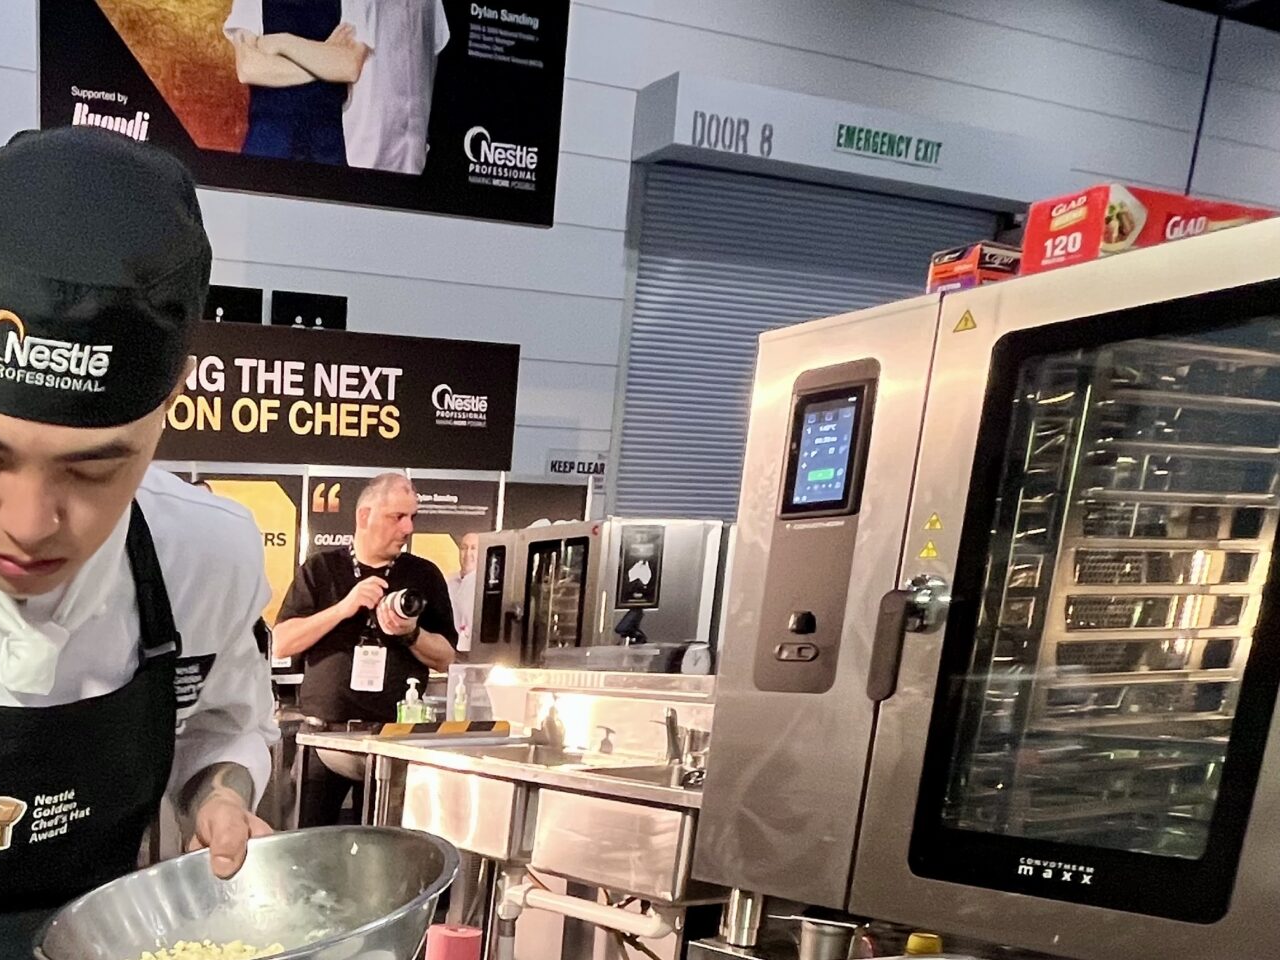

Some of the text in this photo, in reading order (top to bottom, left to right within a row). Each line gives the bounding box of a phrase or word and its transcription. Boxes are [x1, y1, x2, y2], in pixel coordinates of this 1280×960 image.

[470, 2, 540, 30] Dylan Sanding
[71, 85, 129, 105] Supported by
[692, 110, 774, 157] DOOR 8
[836, 124, 942, 164] EMERGENCY EXIT
[468, 162, 537, 181] PROFESSIONAL
[1050, 195, 1088, 217] GLAD
[1165, 215, 1208, 240] GLAD
[1043, 231, 1083, 259] 120
[4, 330, 114, 377] Nestlé
[233, 357, 306, 397] THE
[313, 362, 404, 401] NEXT
[231, 397, 281, 434] OF
[288, 399, 402, 440] CHEFS
[435, 410, 488, 420] PROFESSIONAL
[550, 460, 606, 475] KEEP CLEAR
[34, 788, 76, 807] Nestlé
[30, 806, 91, 832] Chef's Hat
[32, 801, 78, 820] Golden
[28, 823, 68, 845] Award
[1017, 864, 1093, 885] maxx
[1019, 857, 1095, 874] CONVOTHERM
